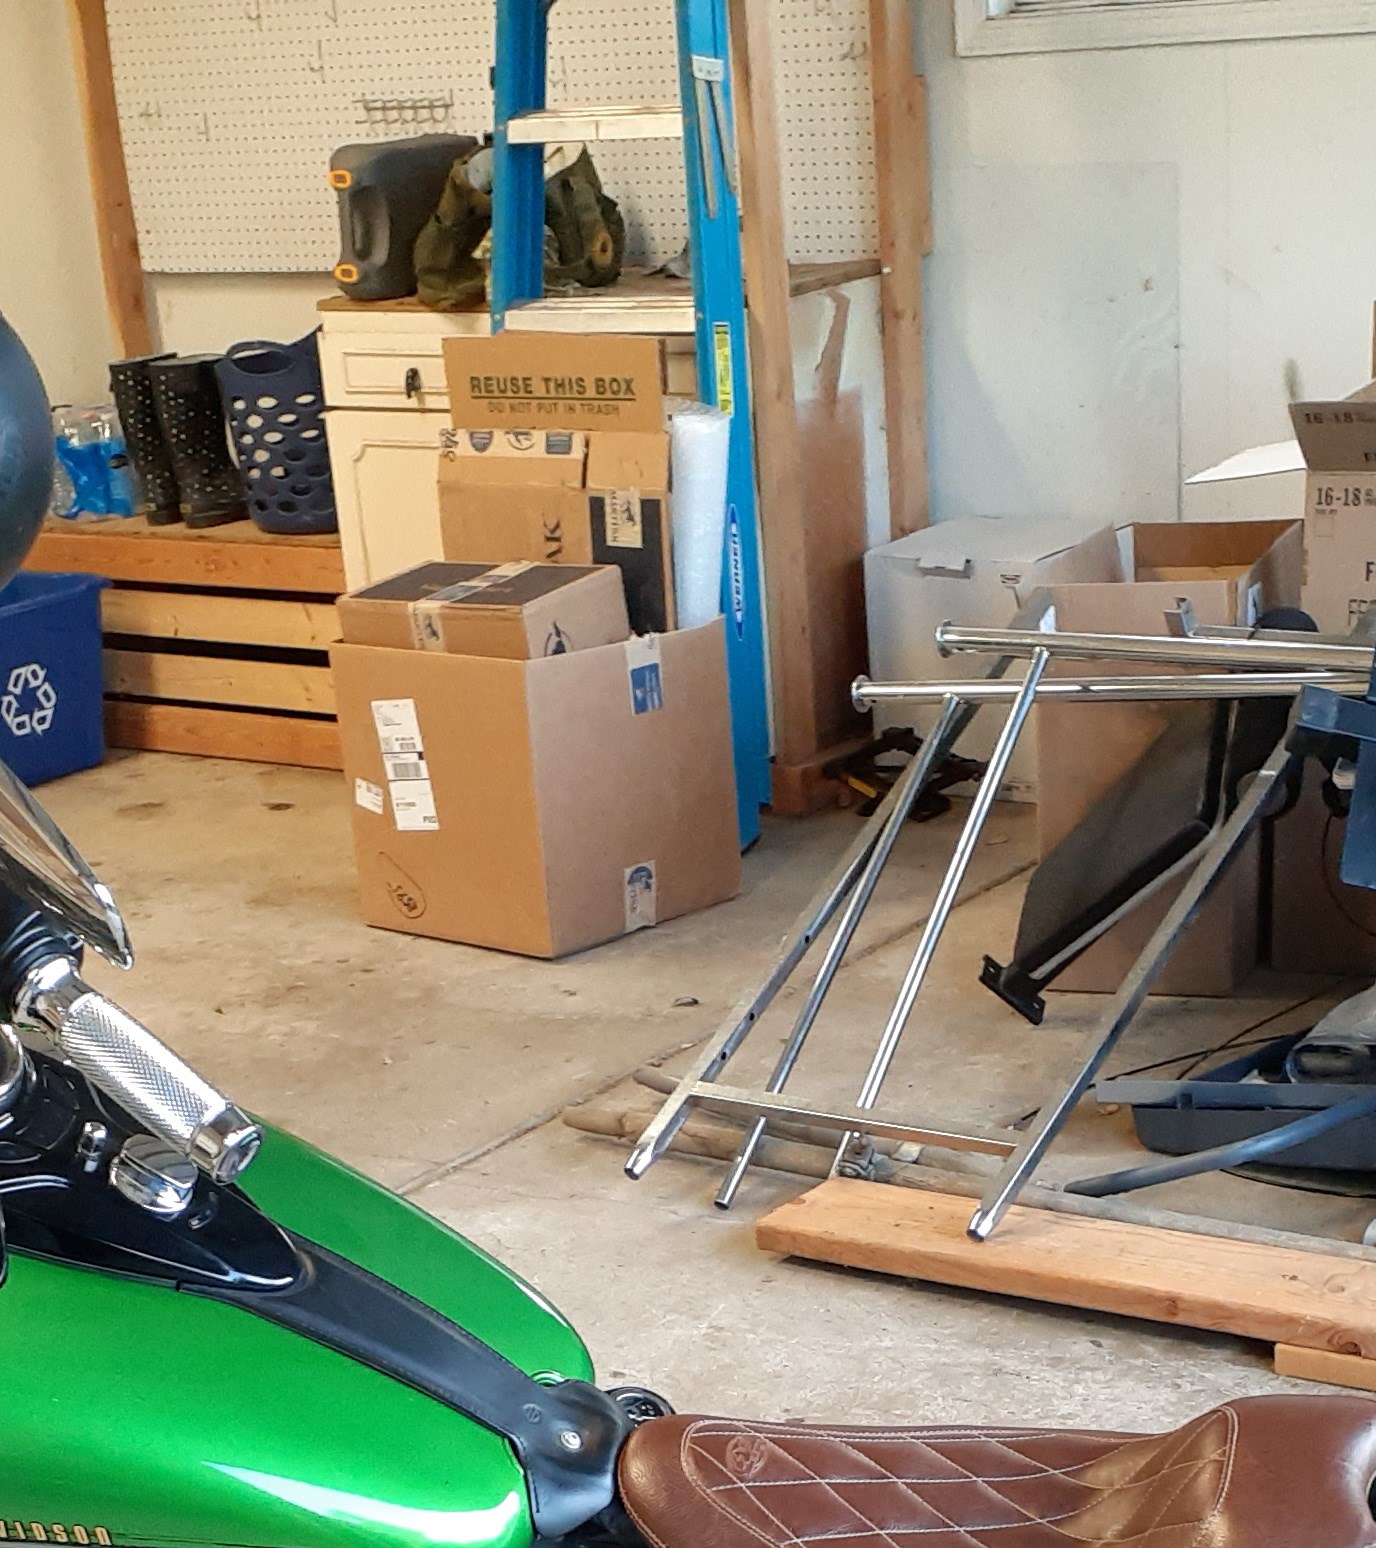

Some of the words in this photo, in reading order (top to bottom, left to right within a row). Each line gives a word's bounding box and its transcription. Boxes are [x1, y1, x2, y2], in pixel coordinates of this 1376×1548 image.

[470, 376, 533, 395] REUSE
[541, 377, 587, 395] THIS
[594, 377, 636, 396] BOX
[509, 402, 532, 413] NOT
[537, 402, 559, 414] PUT
[564, 402, 576, 414] IN
[581, 403, 620, 415] TRASH
[1315, 487, 1362, 507] 16-18
